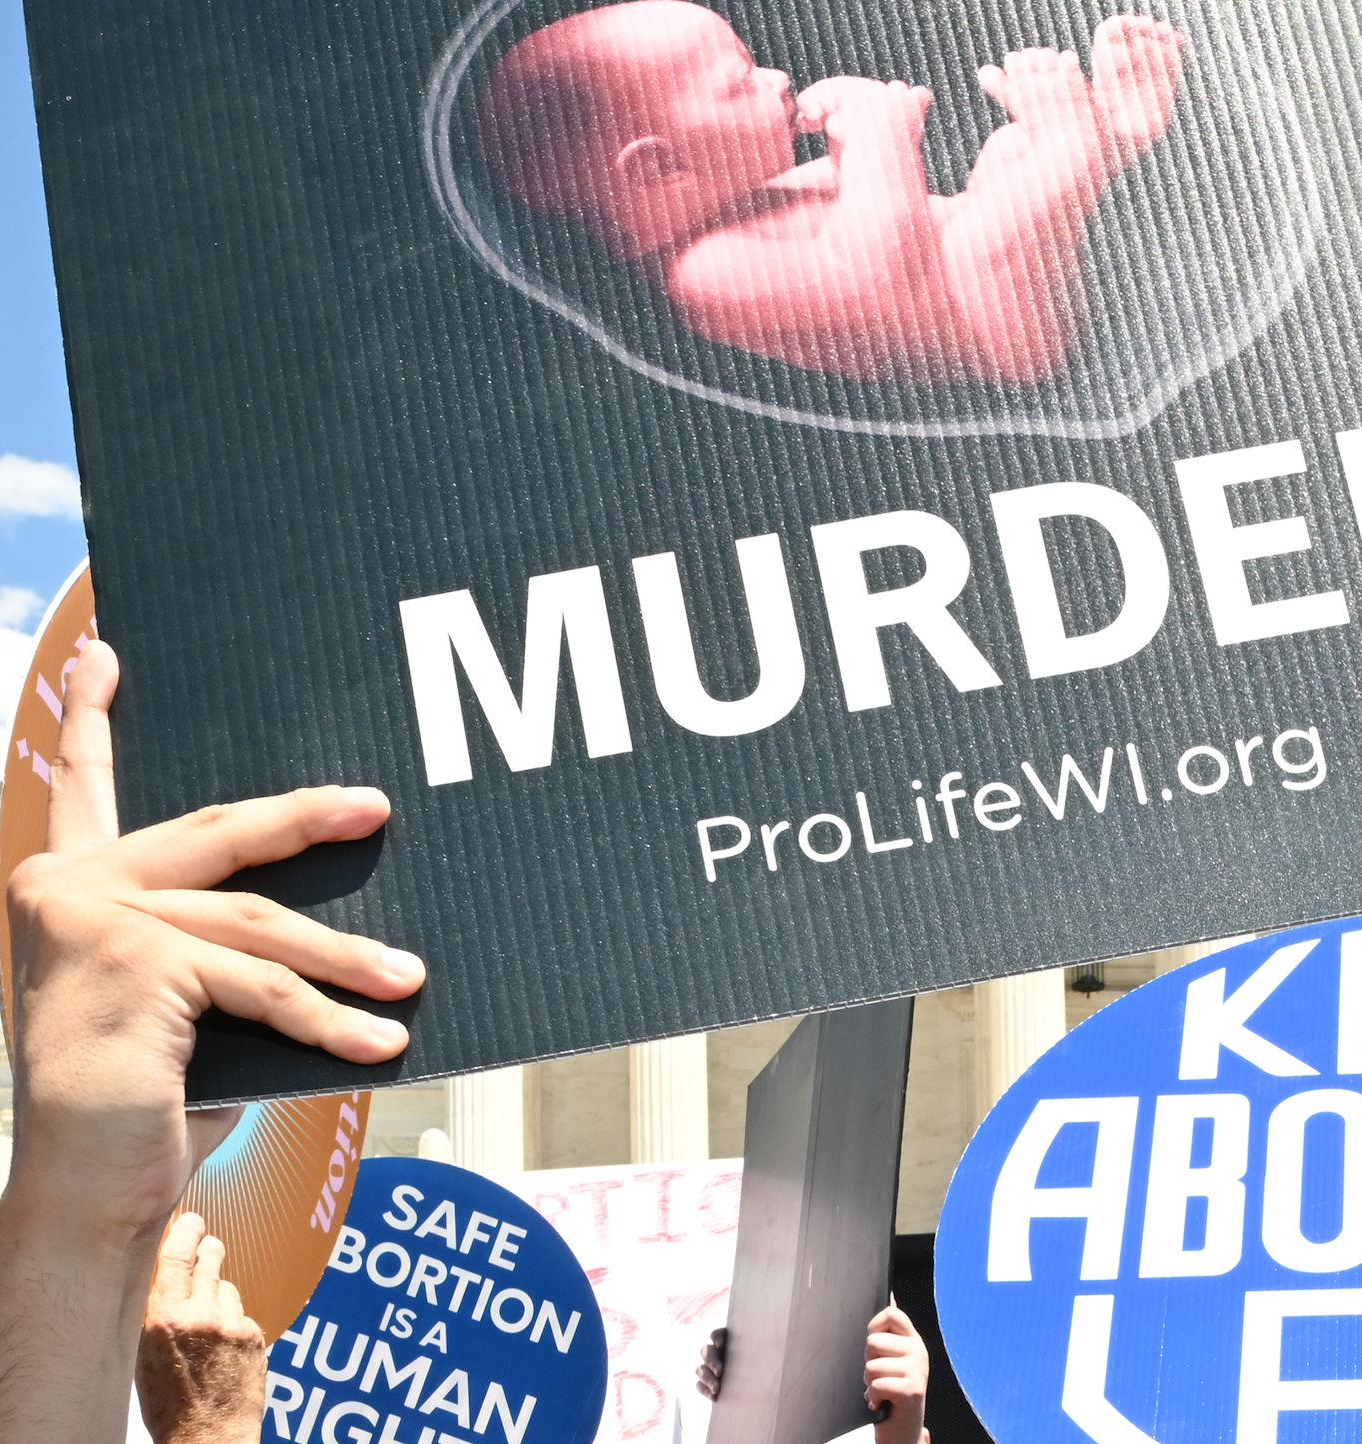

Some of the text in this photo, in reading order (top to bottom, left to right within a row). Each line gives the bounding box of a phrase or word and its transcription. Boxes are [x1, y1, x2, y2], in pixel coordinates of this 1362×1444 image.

[695, 724, 1329, 884] ProLifeWI.org
[383, 1184, 528, 1272] SAFE
[326, 1225, 582, 1355] BORTION
[379, 1302, 448, 1355] IS A
